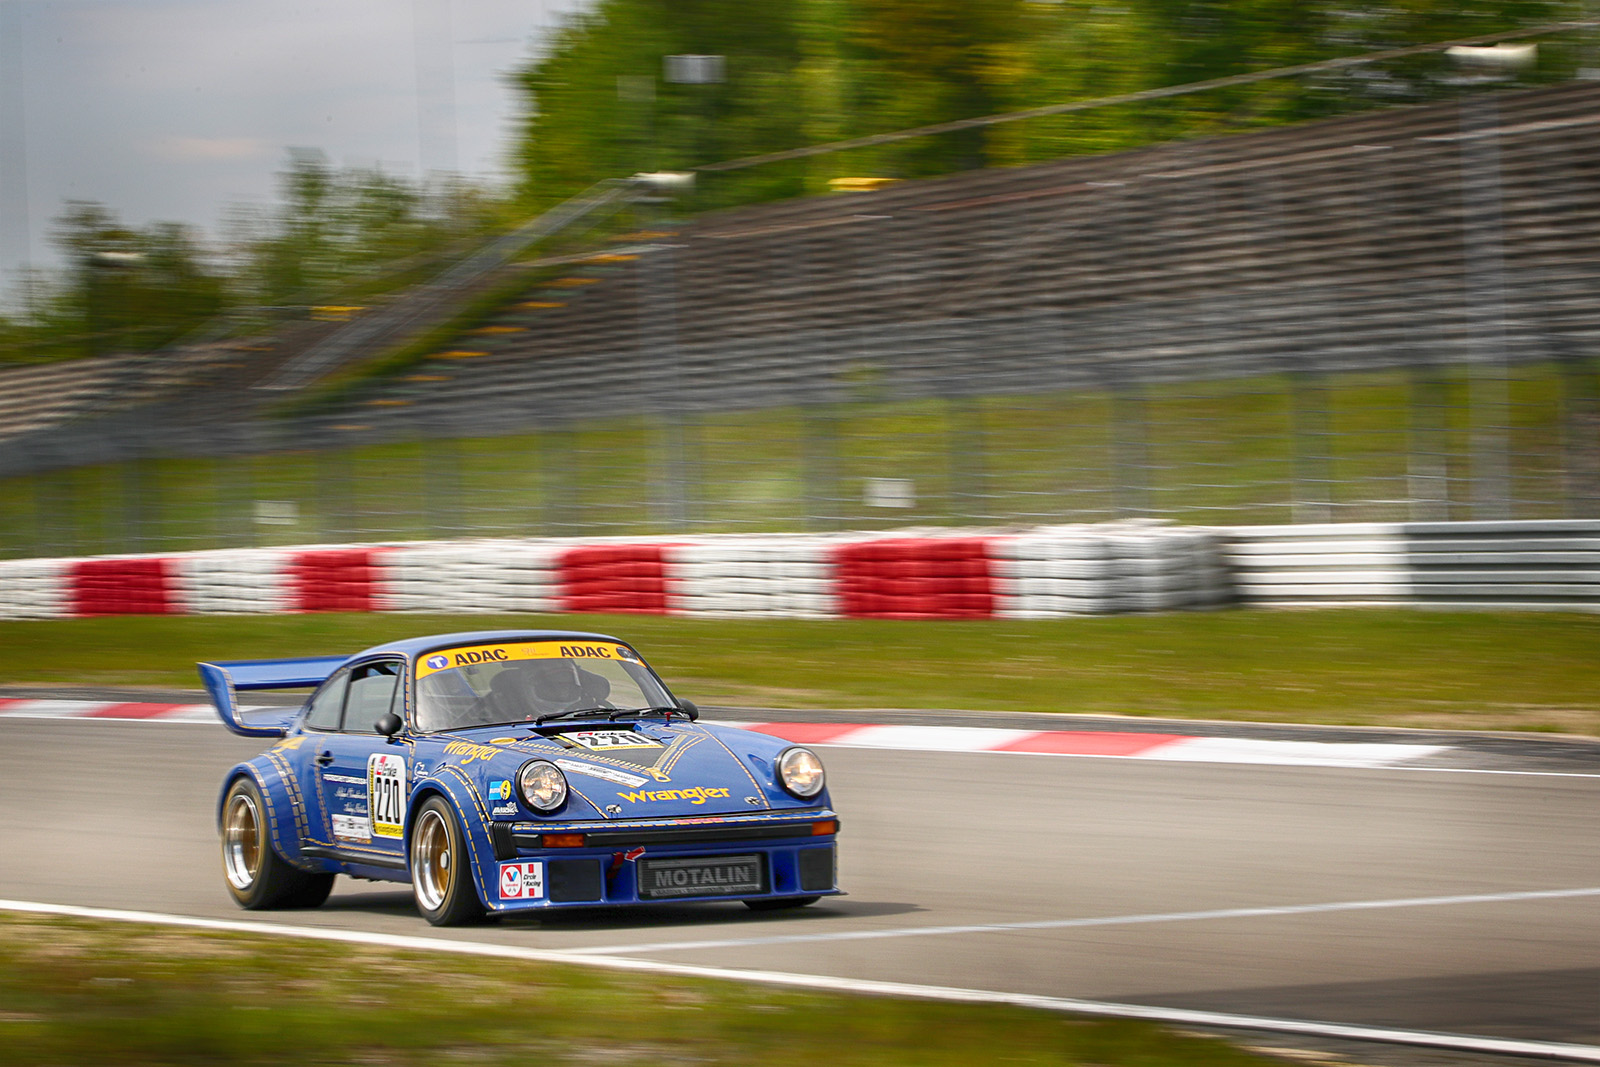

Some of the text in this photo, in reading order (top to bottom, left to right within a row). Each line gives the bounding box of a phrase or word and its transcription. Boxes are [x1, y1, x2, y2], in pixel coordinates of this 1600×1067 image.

[454, 648, 509, 666] ADAC
[560, 645, 611, 658] ADAC
[443, 740, 504, 765] Wrangler
[375, 777, 400, 824] 220
[616, 786, 731, 805] Wrangler
[655, 866, 751, 887] MOTALIN
